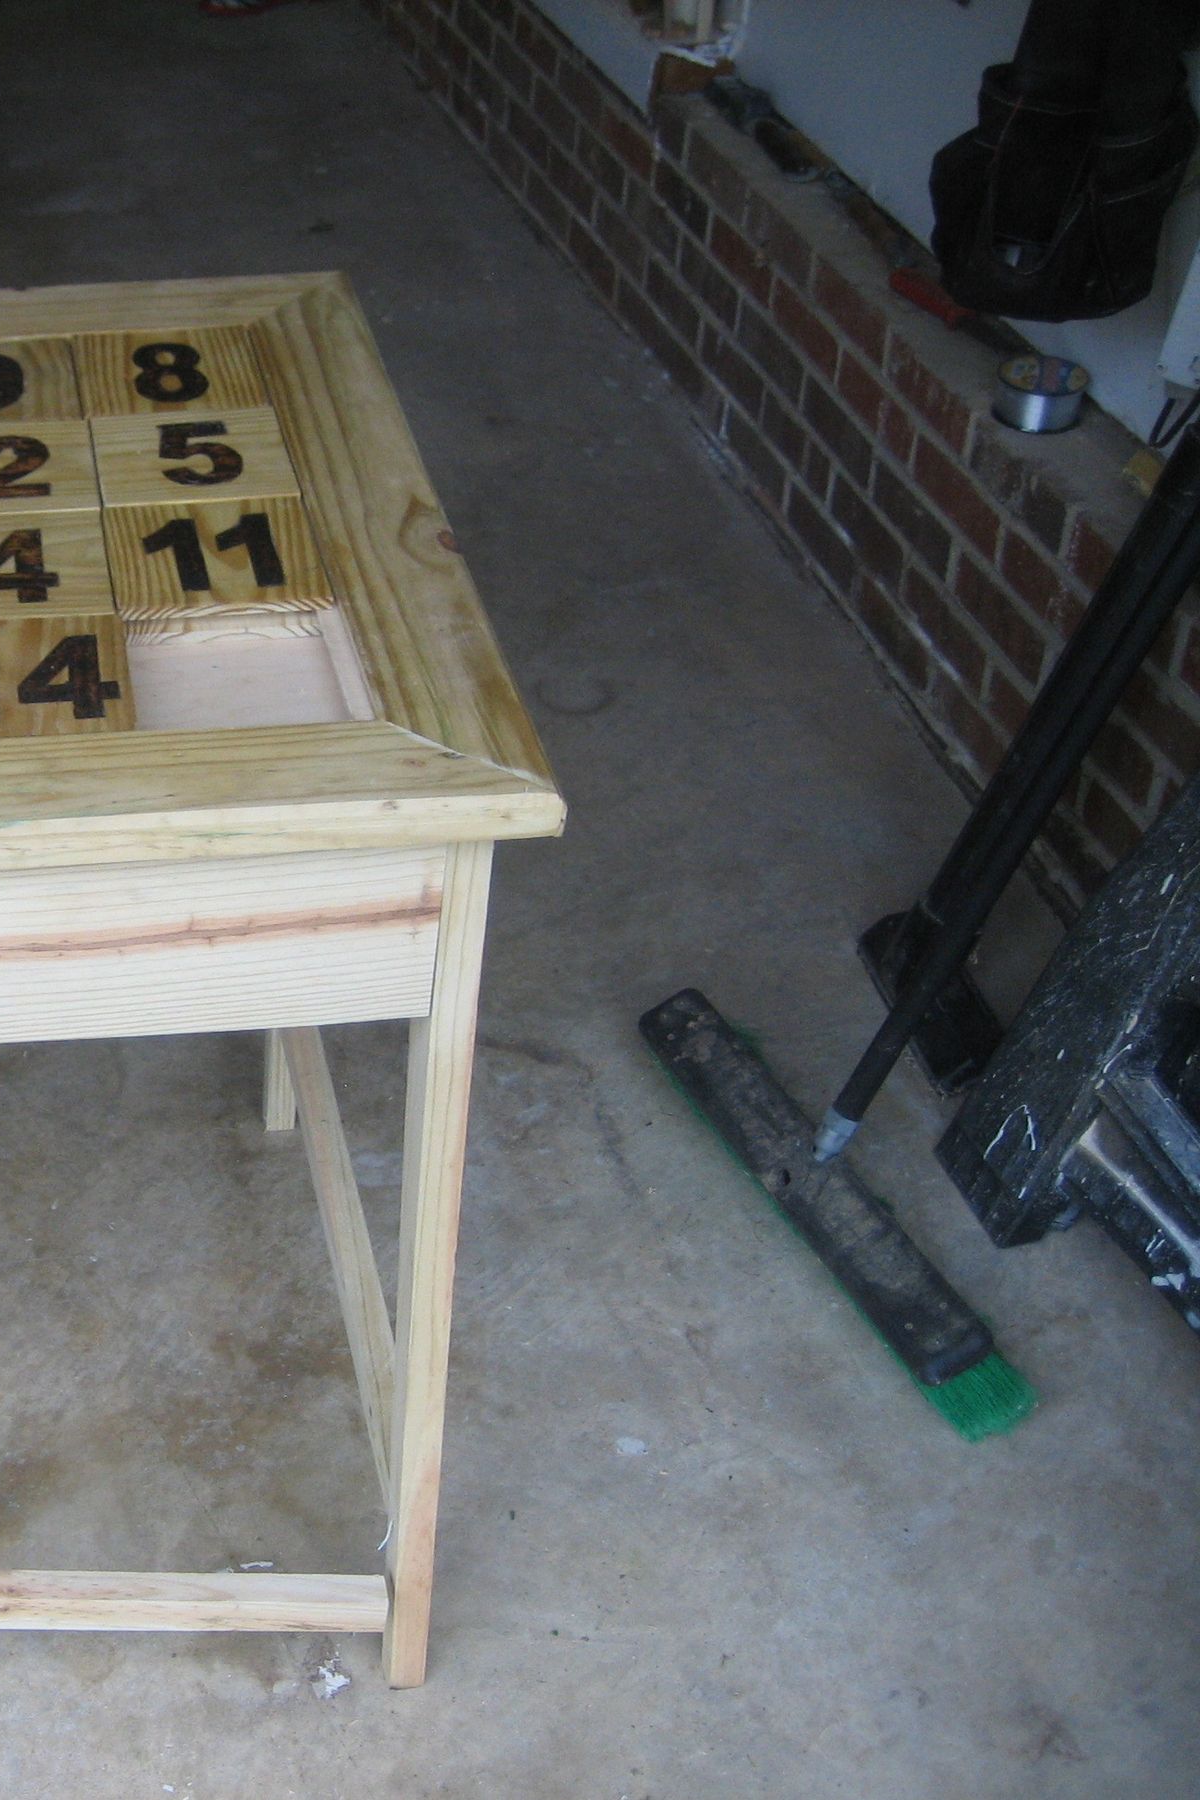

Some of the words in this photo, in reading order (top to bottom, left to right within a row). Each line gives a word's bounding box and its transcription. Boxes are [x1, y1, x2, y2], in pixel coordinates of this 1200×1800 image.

[133, 343, 209, 401] 8
[156, 420, 245, 485] 5
[141, 513, 286, 590] 11
